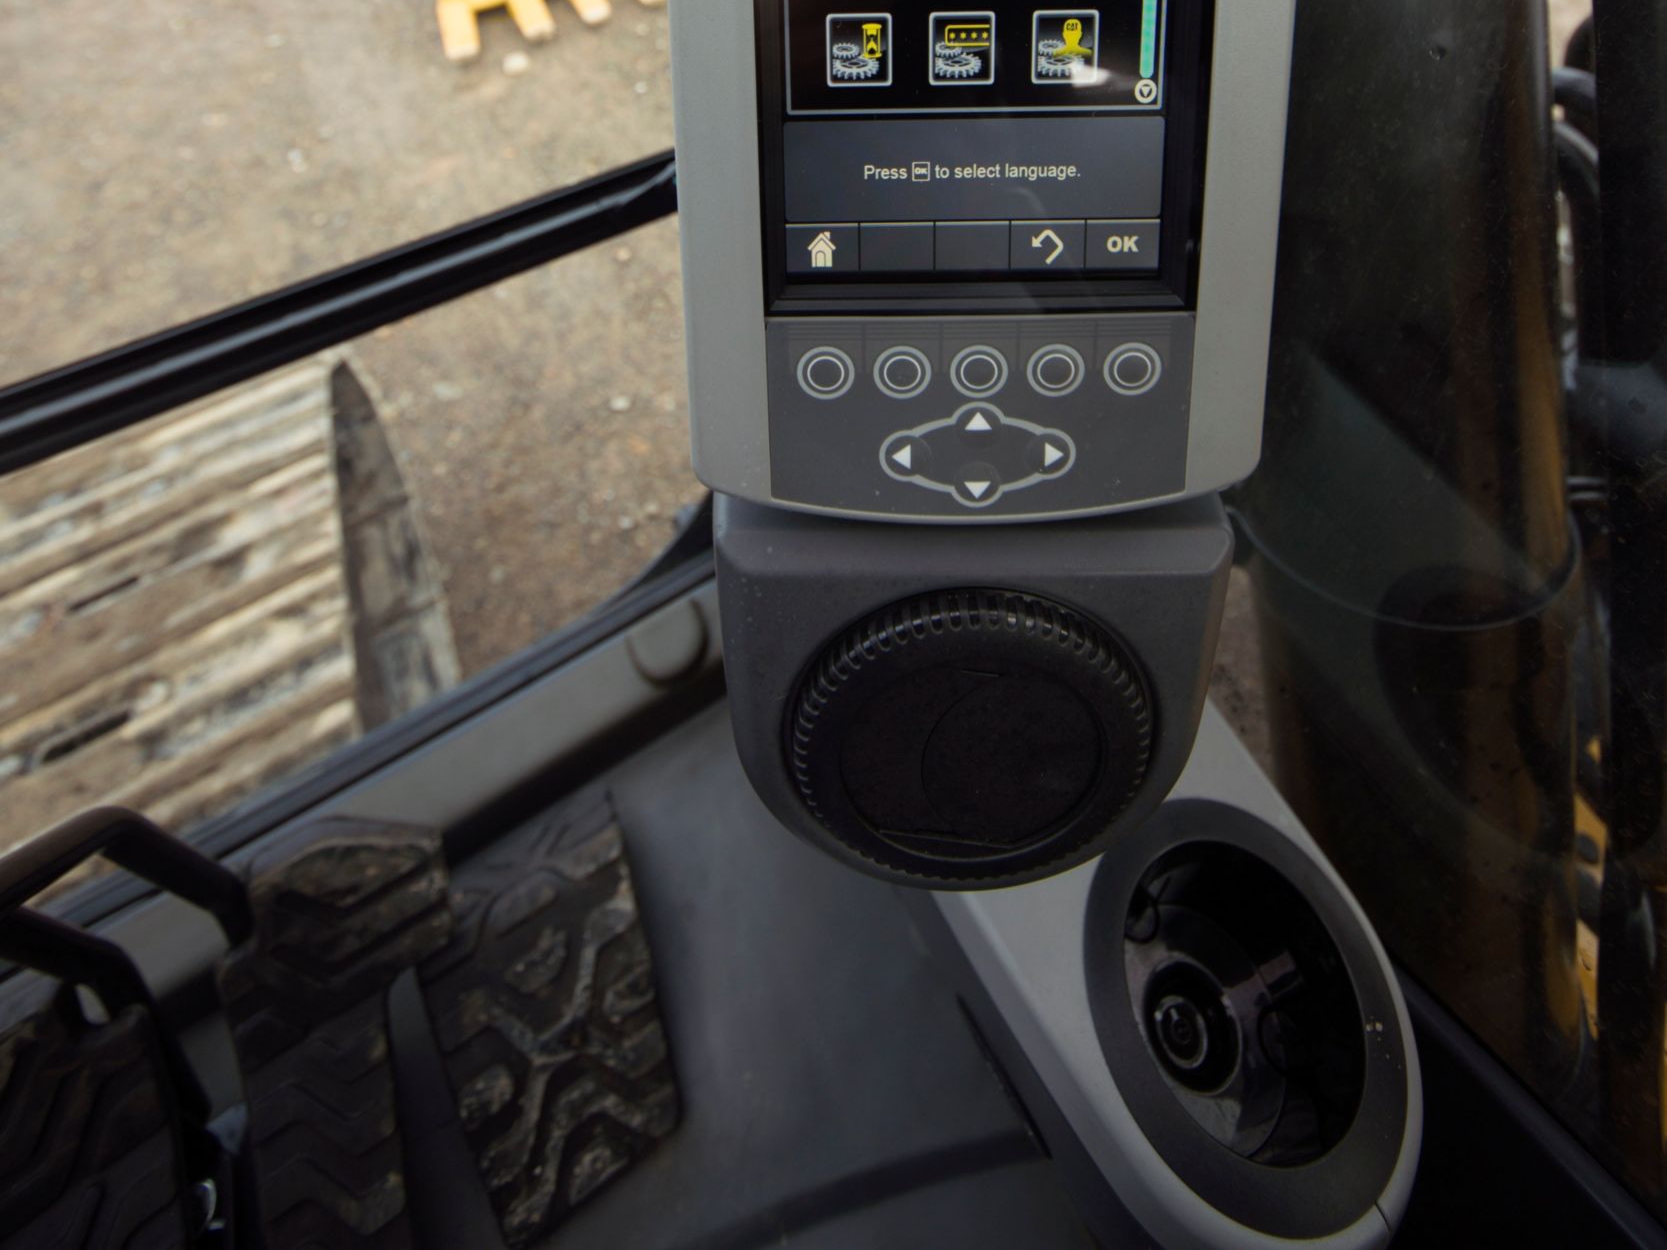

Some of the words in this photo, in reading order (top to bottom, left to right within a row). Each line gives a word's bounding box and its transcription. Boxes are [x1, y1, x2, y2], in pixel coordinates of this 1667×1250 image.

[864, 165, 908, 179] Press
[914, 167, 928, 175] OK
[934, 164, 950, 179] to
[954, 163, 1001, 178] select
[1005, 162, 1081, 181] language.
[1107, 236, 1138, 252] OK
